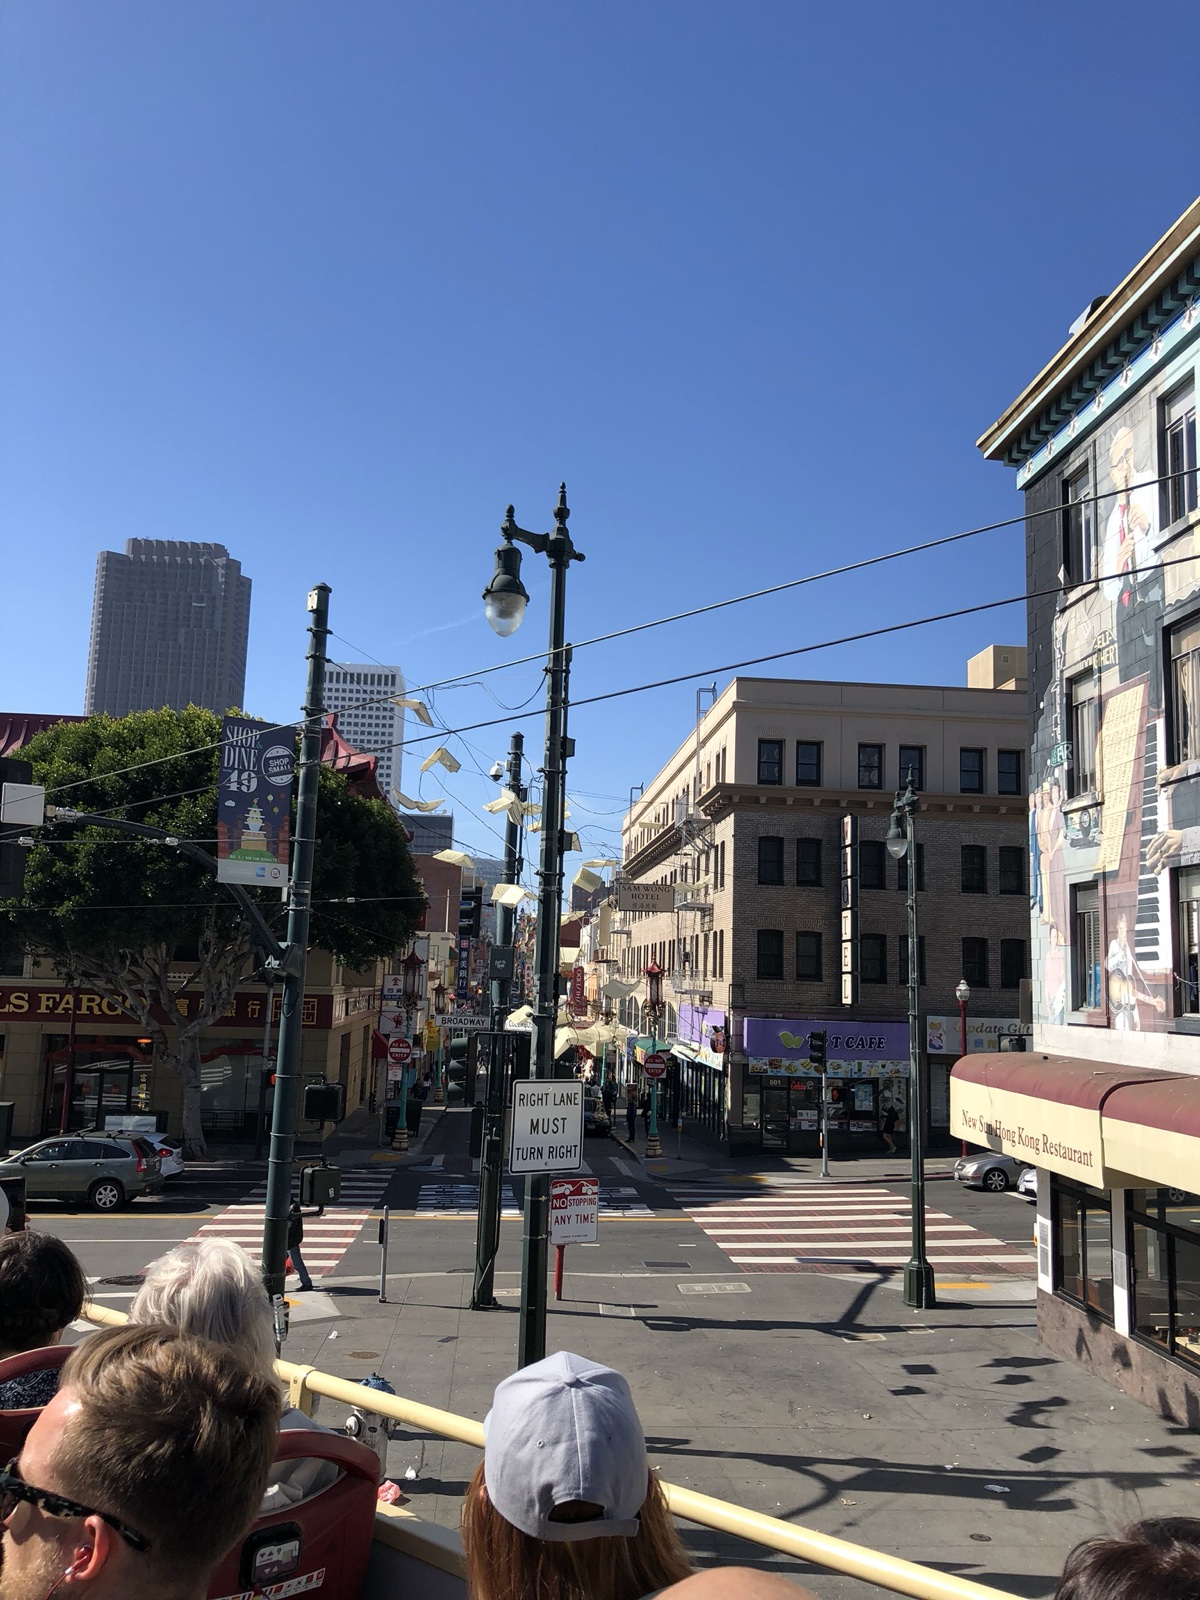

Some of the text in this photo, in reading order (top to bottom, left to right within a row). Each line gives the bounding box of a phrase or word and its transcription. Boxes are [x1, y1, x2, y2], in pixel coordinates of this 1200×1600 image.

[226, 725, 260, 748] SHOP
[223, 745, 258, 770] DINE
[269, 758, 289, 767] SHOP
[268, 765, 291, 774] SMALL
[222, 770, 258, 793] 49
[442, 1017, 486, 1026] BROADWAY
[845, 1036, 886, 1050] CAFE
[518, 1092, 579, 1107] RIGHT LANE
[530, 1117, 567, 1135] MUST
[962, 1109, 1093, 1168] New Sun Hong Kong Restaurant
[516, 1145, 578, 1162] TURN RIGHT
[553, 1197, 597, 1208] NO STOPPING
[554, 1213, 595, 1225] ANY TIME
